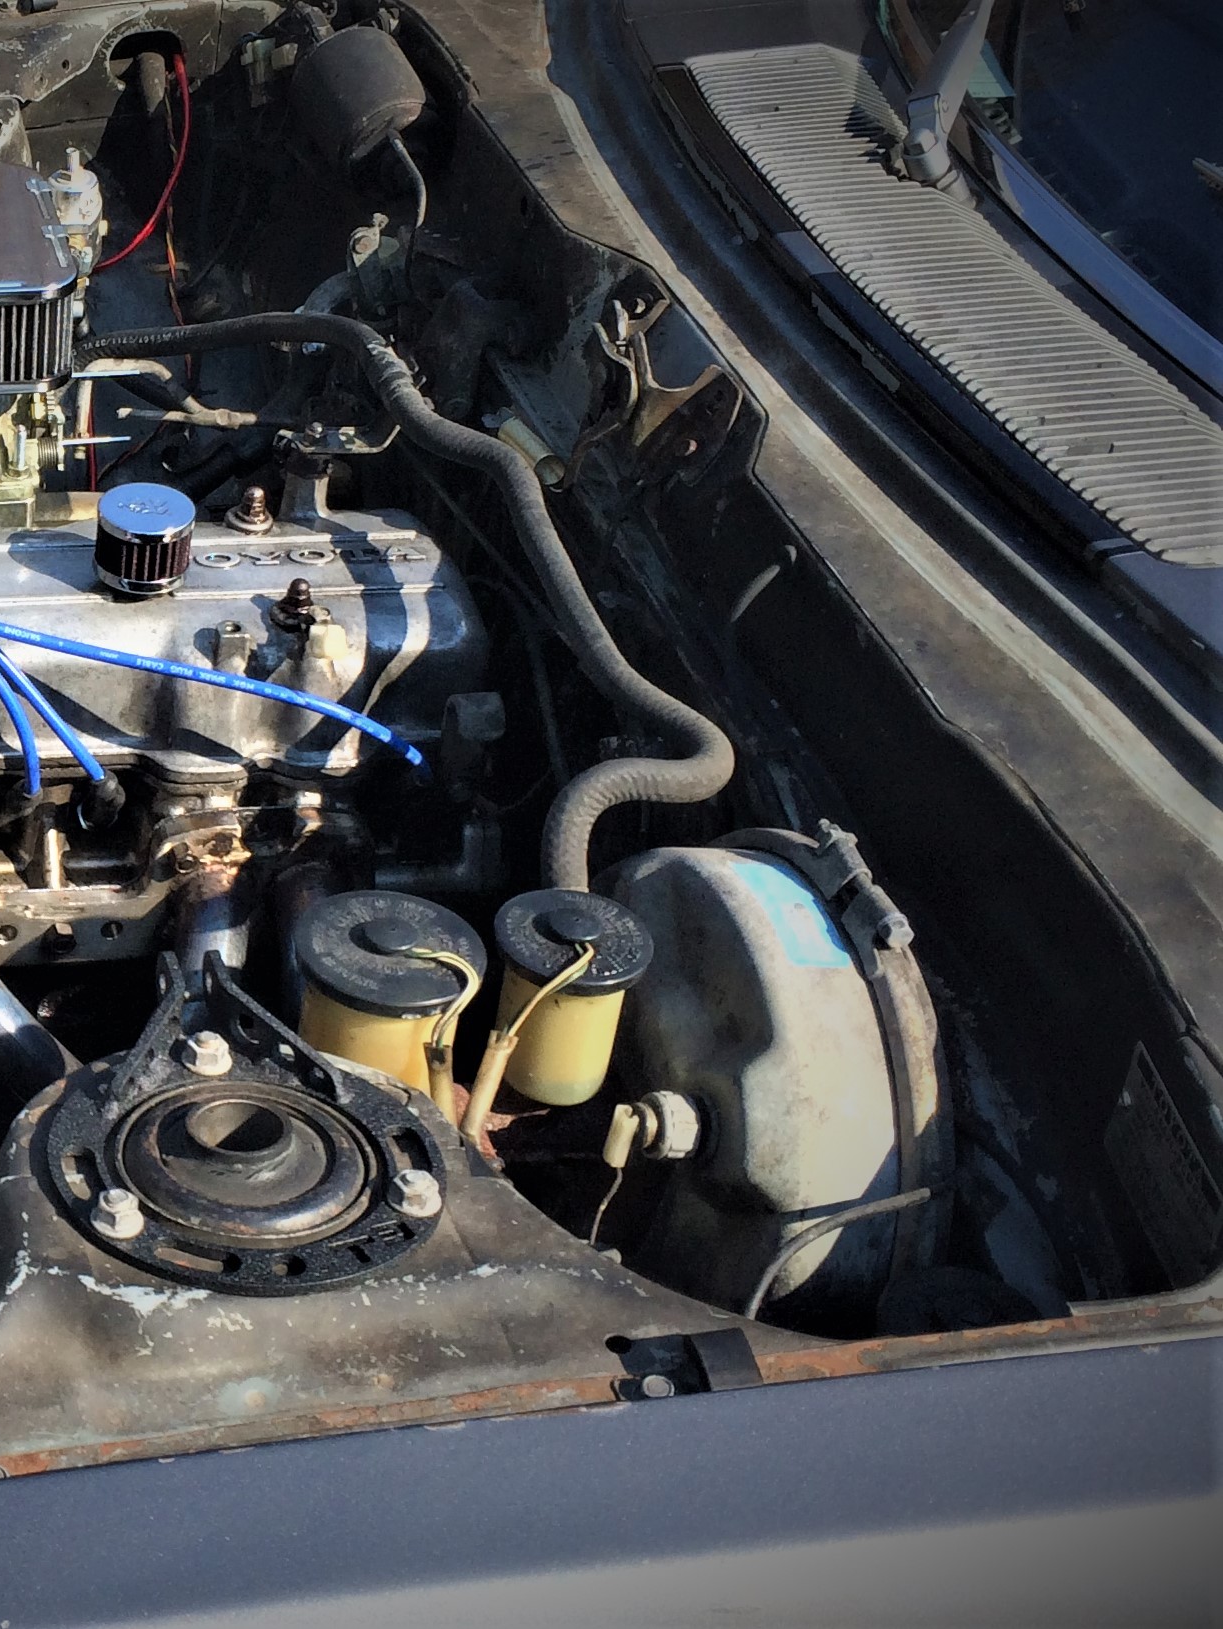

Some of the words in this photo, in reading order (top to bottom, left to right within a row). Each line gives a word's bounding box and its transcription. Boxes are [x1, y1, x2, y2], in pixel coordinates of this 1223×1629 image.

[193, 545, 427, 569] OYOTA
[136, 658, 164, 670] CABLE
[170, 665, 193, 676] PLUG
[199, 671, 226, 683] SPARK
